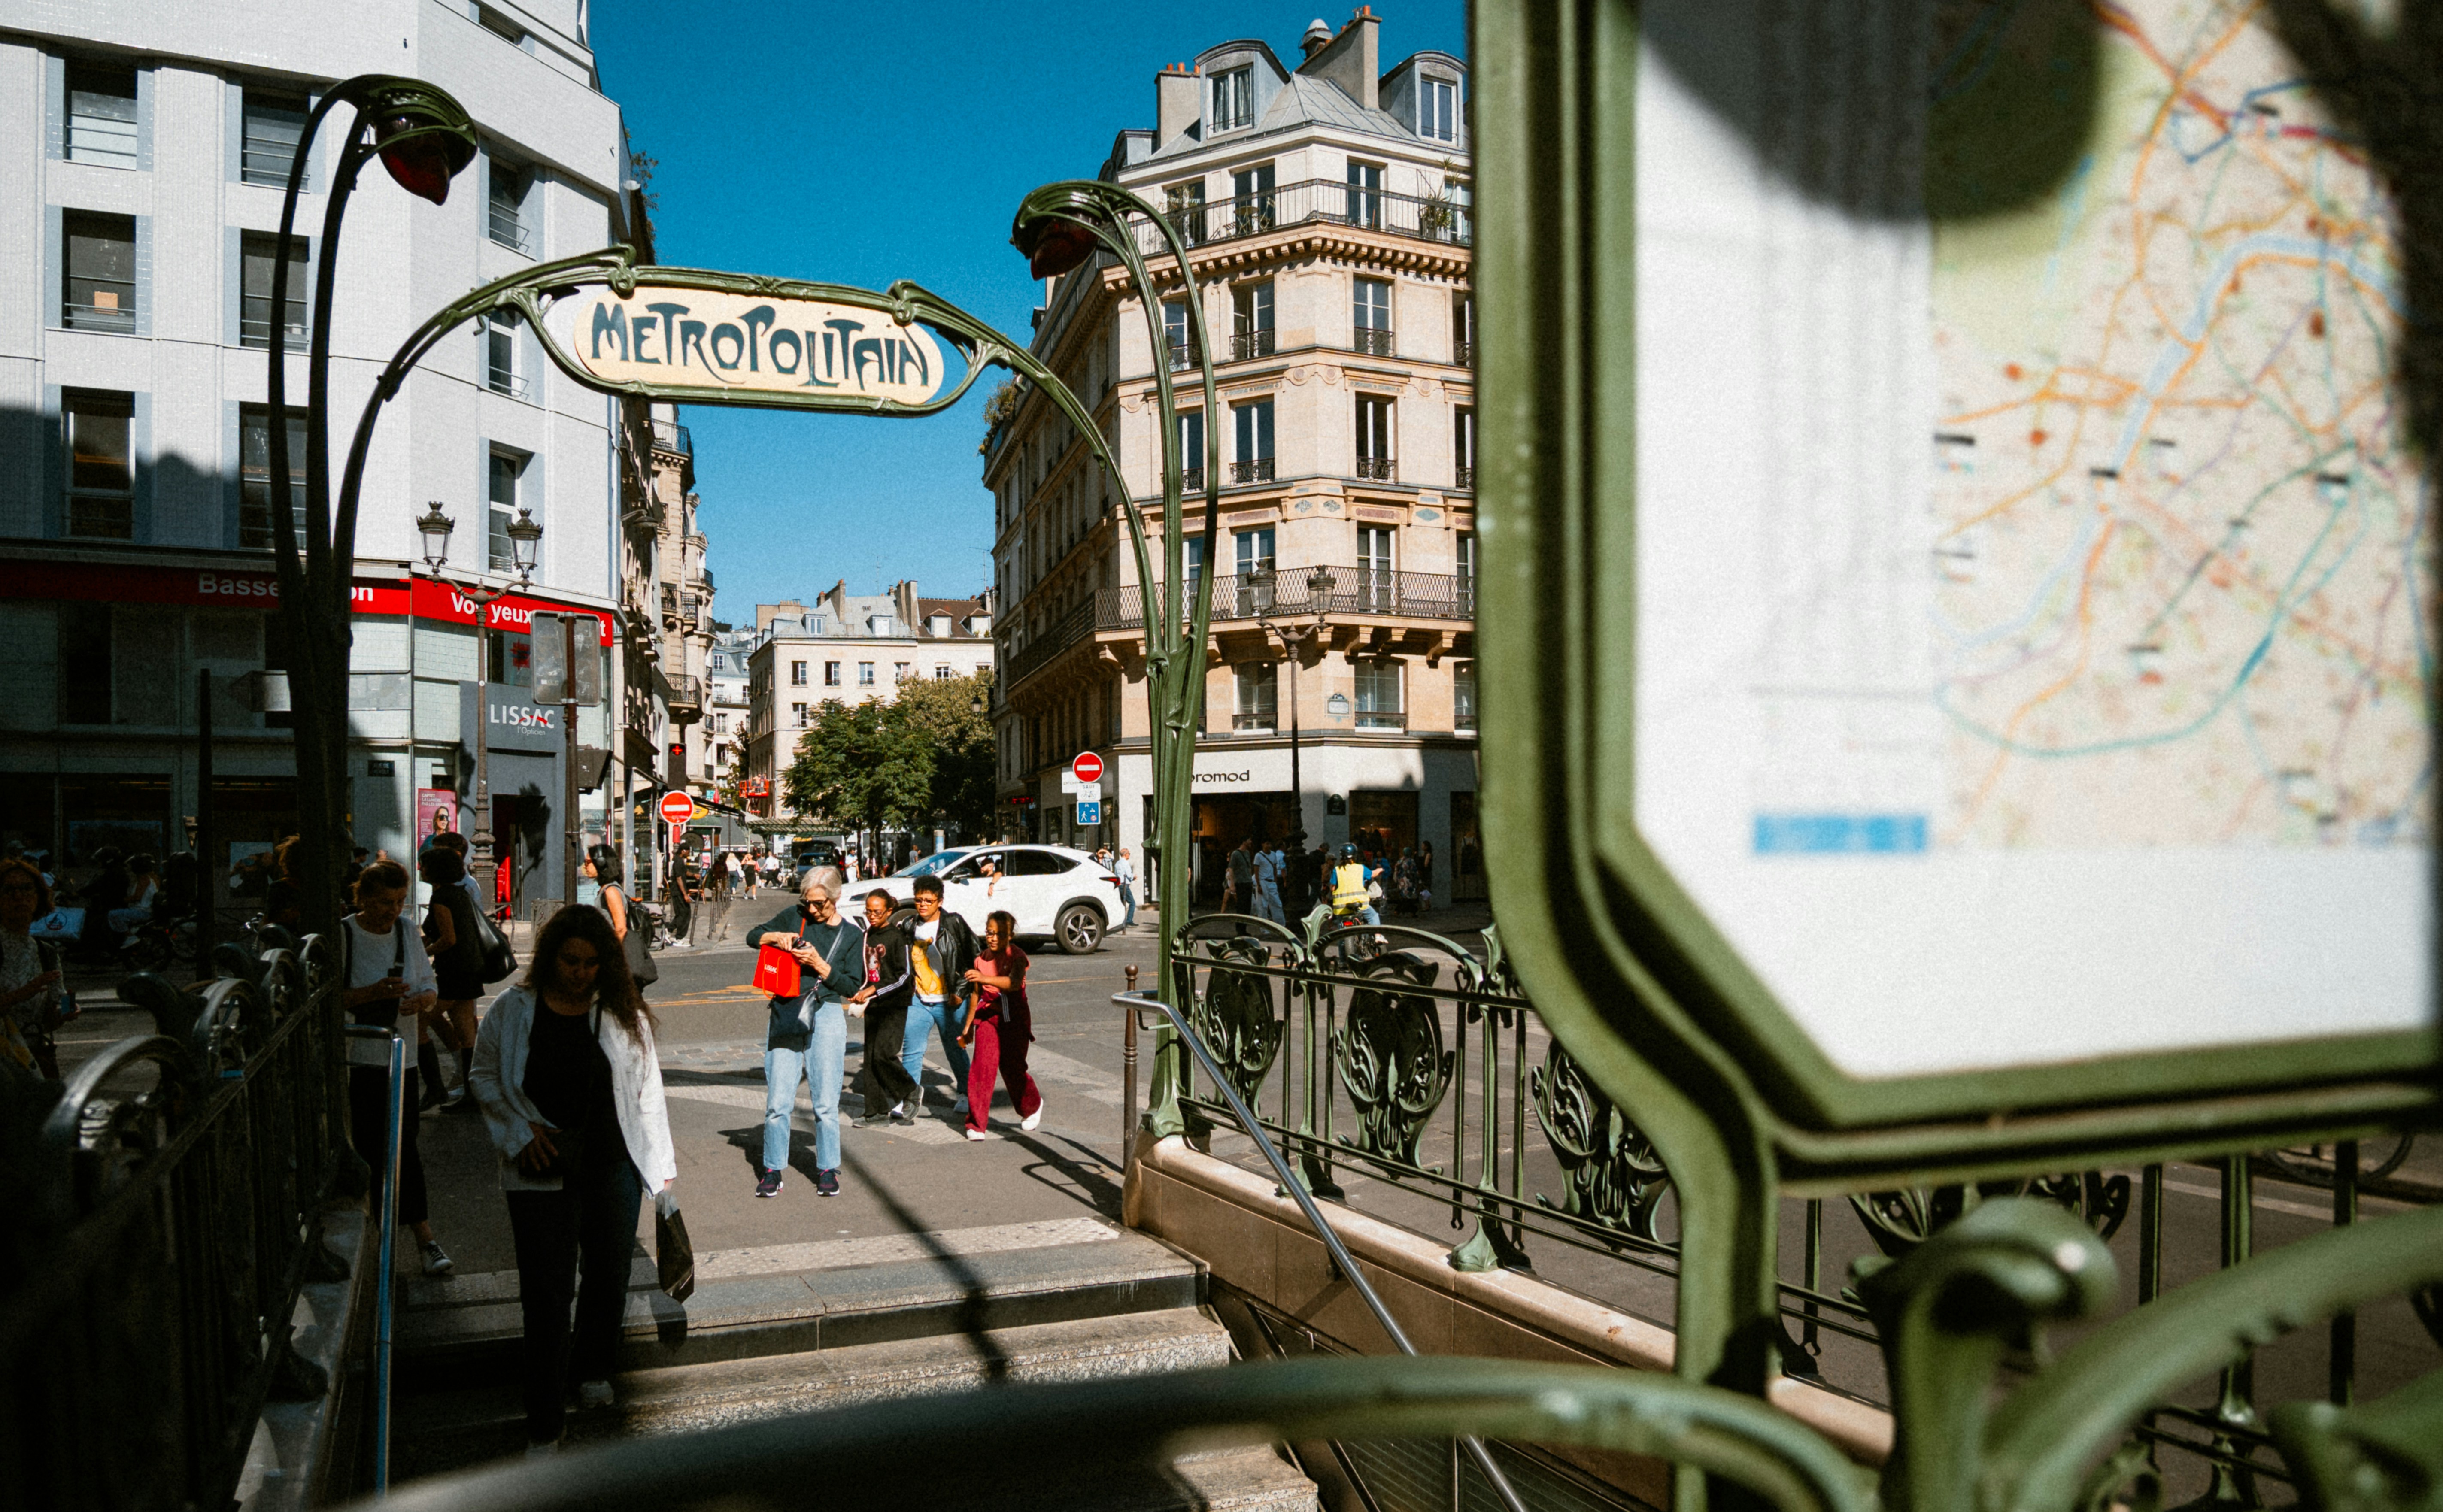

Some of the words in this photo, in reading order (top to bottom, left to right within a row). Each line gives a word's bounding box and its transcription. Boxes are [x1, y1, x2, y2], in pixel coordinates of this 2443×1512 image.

[591, 302, 929, 391] METROPOLITAIN
[491, 604, 532, 624] yeux
[490, 704, 555, 729] LISSAC
[517, 726, 546, 736] l'Opticien
